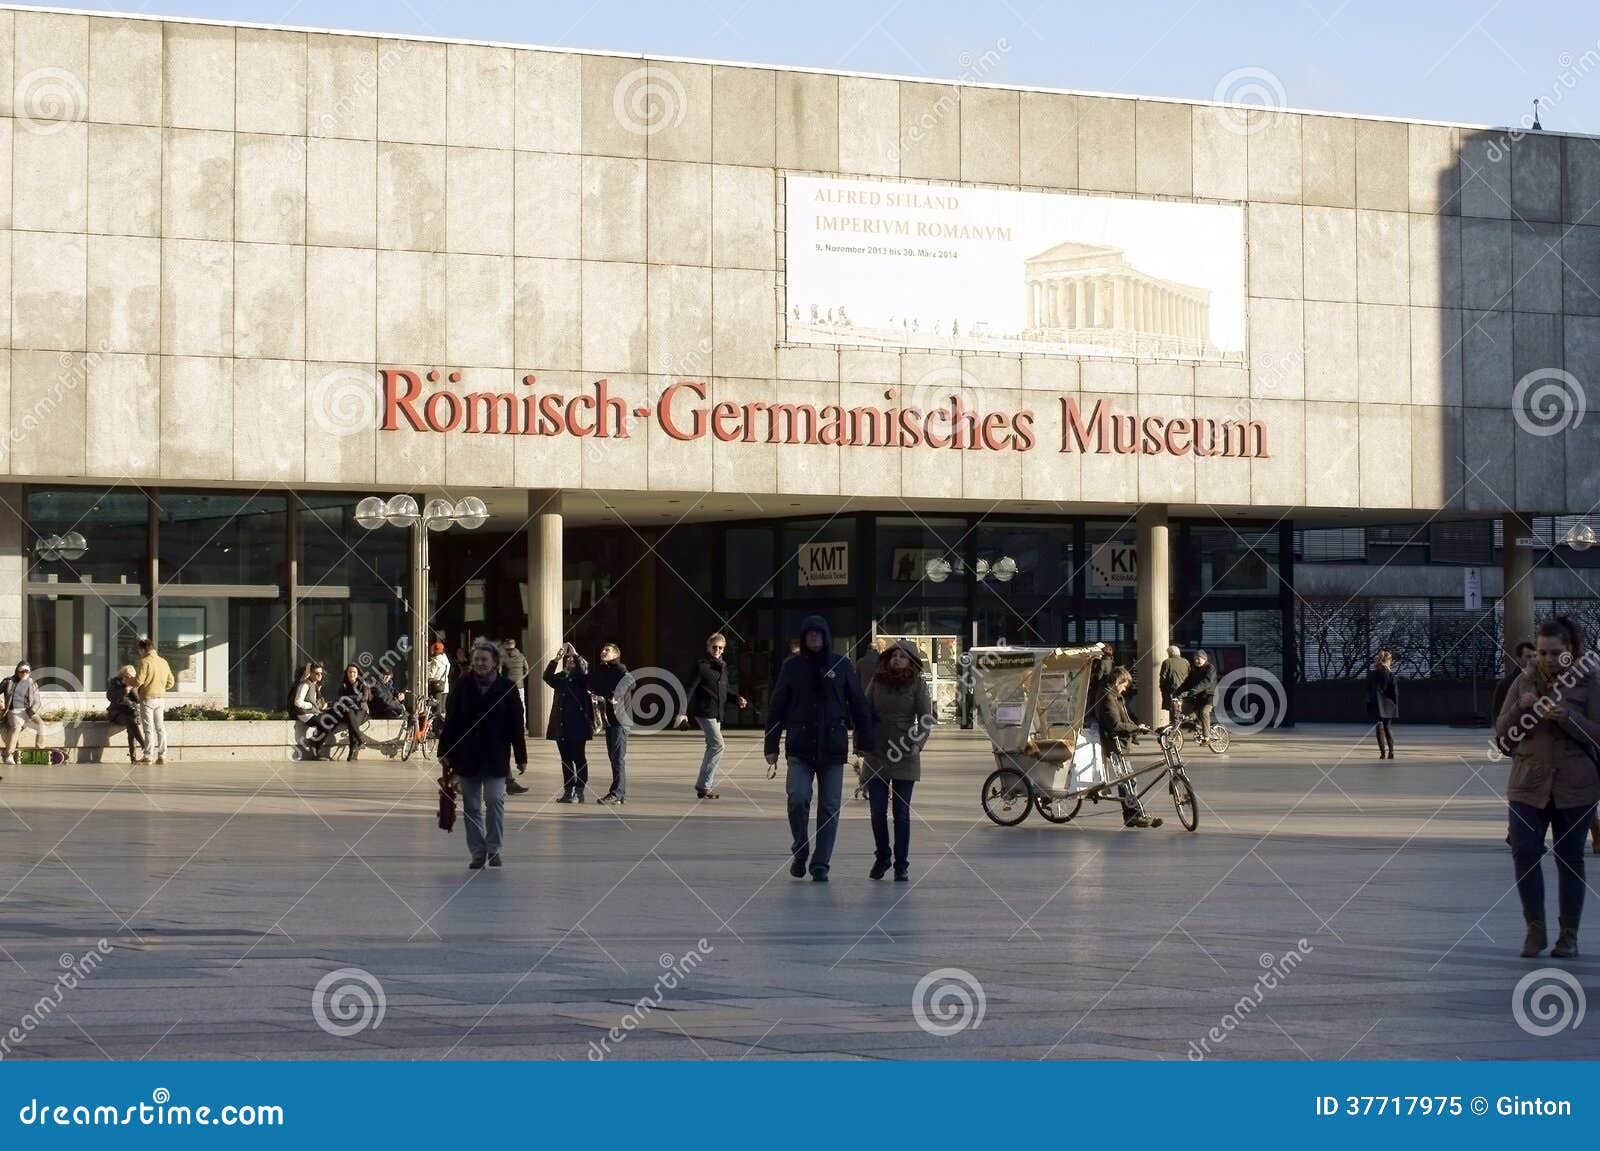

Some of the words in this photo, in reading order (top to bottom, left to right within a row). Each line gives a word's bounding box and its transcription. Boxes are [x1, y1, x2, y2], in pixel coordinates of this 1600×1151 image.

[815, 188, 881, 206] ALFRED
[815, 215, 910, 236] IMPERIVM
[916, 222, 1013, 242] ROMANVM
[815, 243, 823, 252] 9.
[825, 244, 866, 255] November
[867, 246, 887, 256] 2013
[938, 250, 958, 260] 2014
[377, 368, 1036, 452] Römisch-Germanisches
[1058, 396, 1271, 459] Museum
[810, 545, 846, 572] KMT
